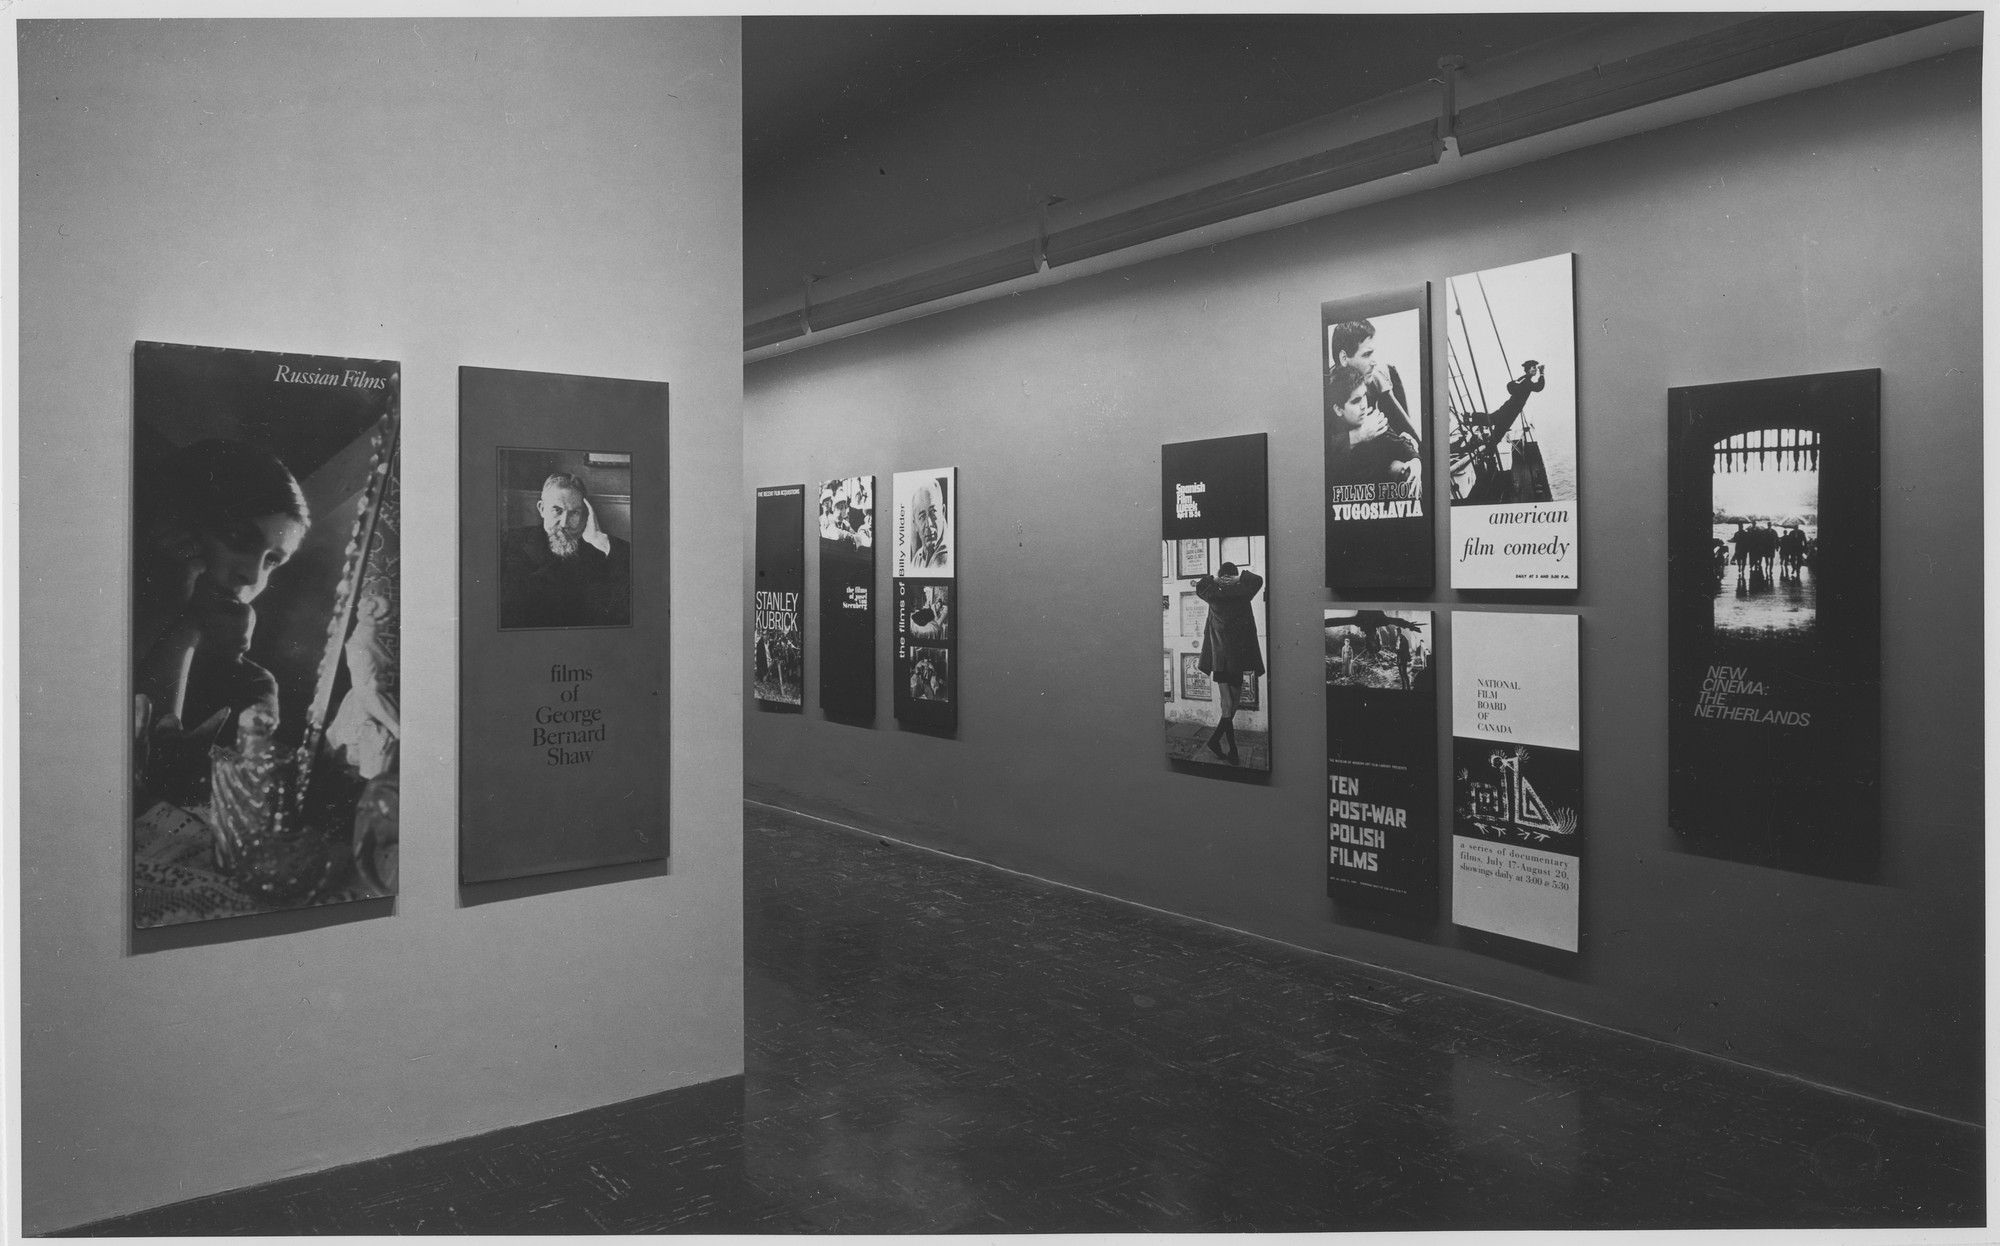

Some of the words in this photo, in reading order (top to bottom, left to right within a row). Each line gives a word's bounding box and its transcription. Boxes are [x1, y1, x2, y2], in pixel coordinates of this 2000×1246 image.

[273, 364, 340, 386] Russian
[340, 369, 387, 390] Films
[1176, 481, 1206, 494] Spanish
[1332, 483, 1376, 503] FILMS
[1332, 500, 1424, 521] YUGOSLAVIA
[1488, 505, 1569, 525] american
[898, 503, 906, 546] Wilder
[1459, 537, 1495, 562] film
[1503, 535, 1570, 562] comedy
[898, 551, 907, 577] Billy
[898, 582, 906, 595] of
[756, 590, 799, 611] STANLEY
[755, 610, 798, 631] KUBRICK
[898, 600, 906, 632] films
[898, 637, 906, 658] the
[550, 664, 593, 682] films
[1706, 665, 1748, 680] NEW
[560, 684, 580, 703] of
[1477, 679, 1521, 690] NATIONAL
[1477, 689, 1498, 699] FILM
[1702, 678, 1770, 696] CINEMA:
[1477, 701, 1507, 711] BOARD
[1699, 691, 1728, 706] THE
[535, 705, 602, 727] George
[1477, 712, 1490, 720] OF
[1694, 704, 1811, 727] NETHERLANDS
[532, 723, 606, 747] Bernard
[1477, 723, 1512, 734] CANADA
[547, 747, 594, 766] Shaw
[1329, 775, 1359, 796] TEN
[1329, 799, 1407, 829] POST-WAR
[1329, 822, 1385, 849] POLISH
[1330, 845, 1378, 872] FILMS
[1469, 844, 1493, 854] series
[1497, 848, 1507, 856] of
[1509, 849, 1569, 870] documentary
[1486, 856, 1504, 869] July
[1459, 862, 1493, 877] showings
[1495, 869, 1514, 882] daily
[1551, 880, 1570, 891] 5:30
